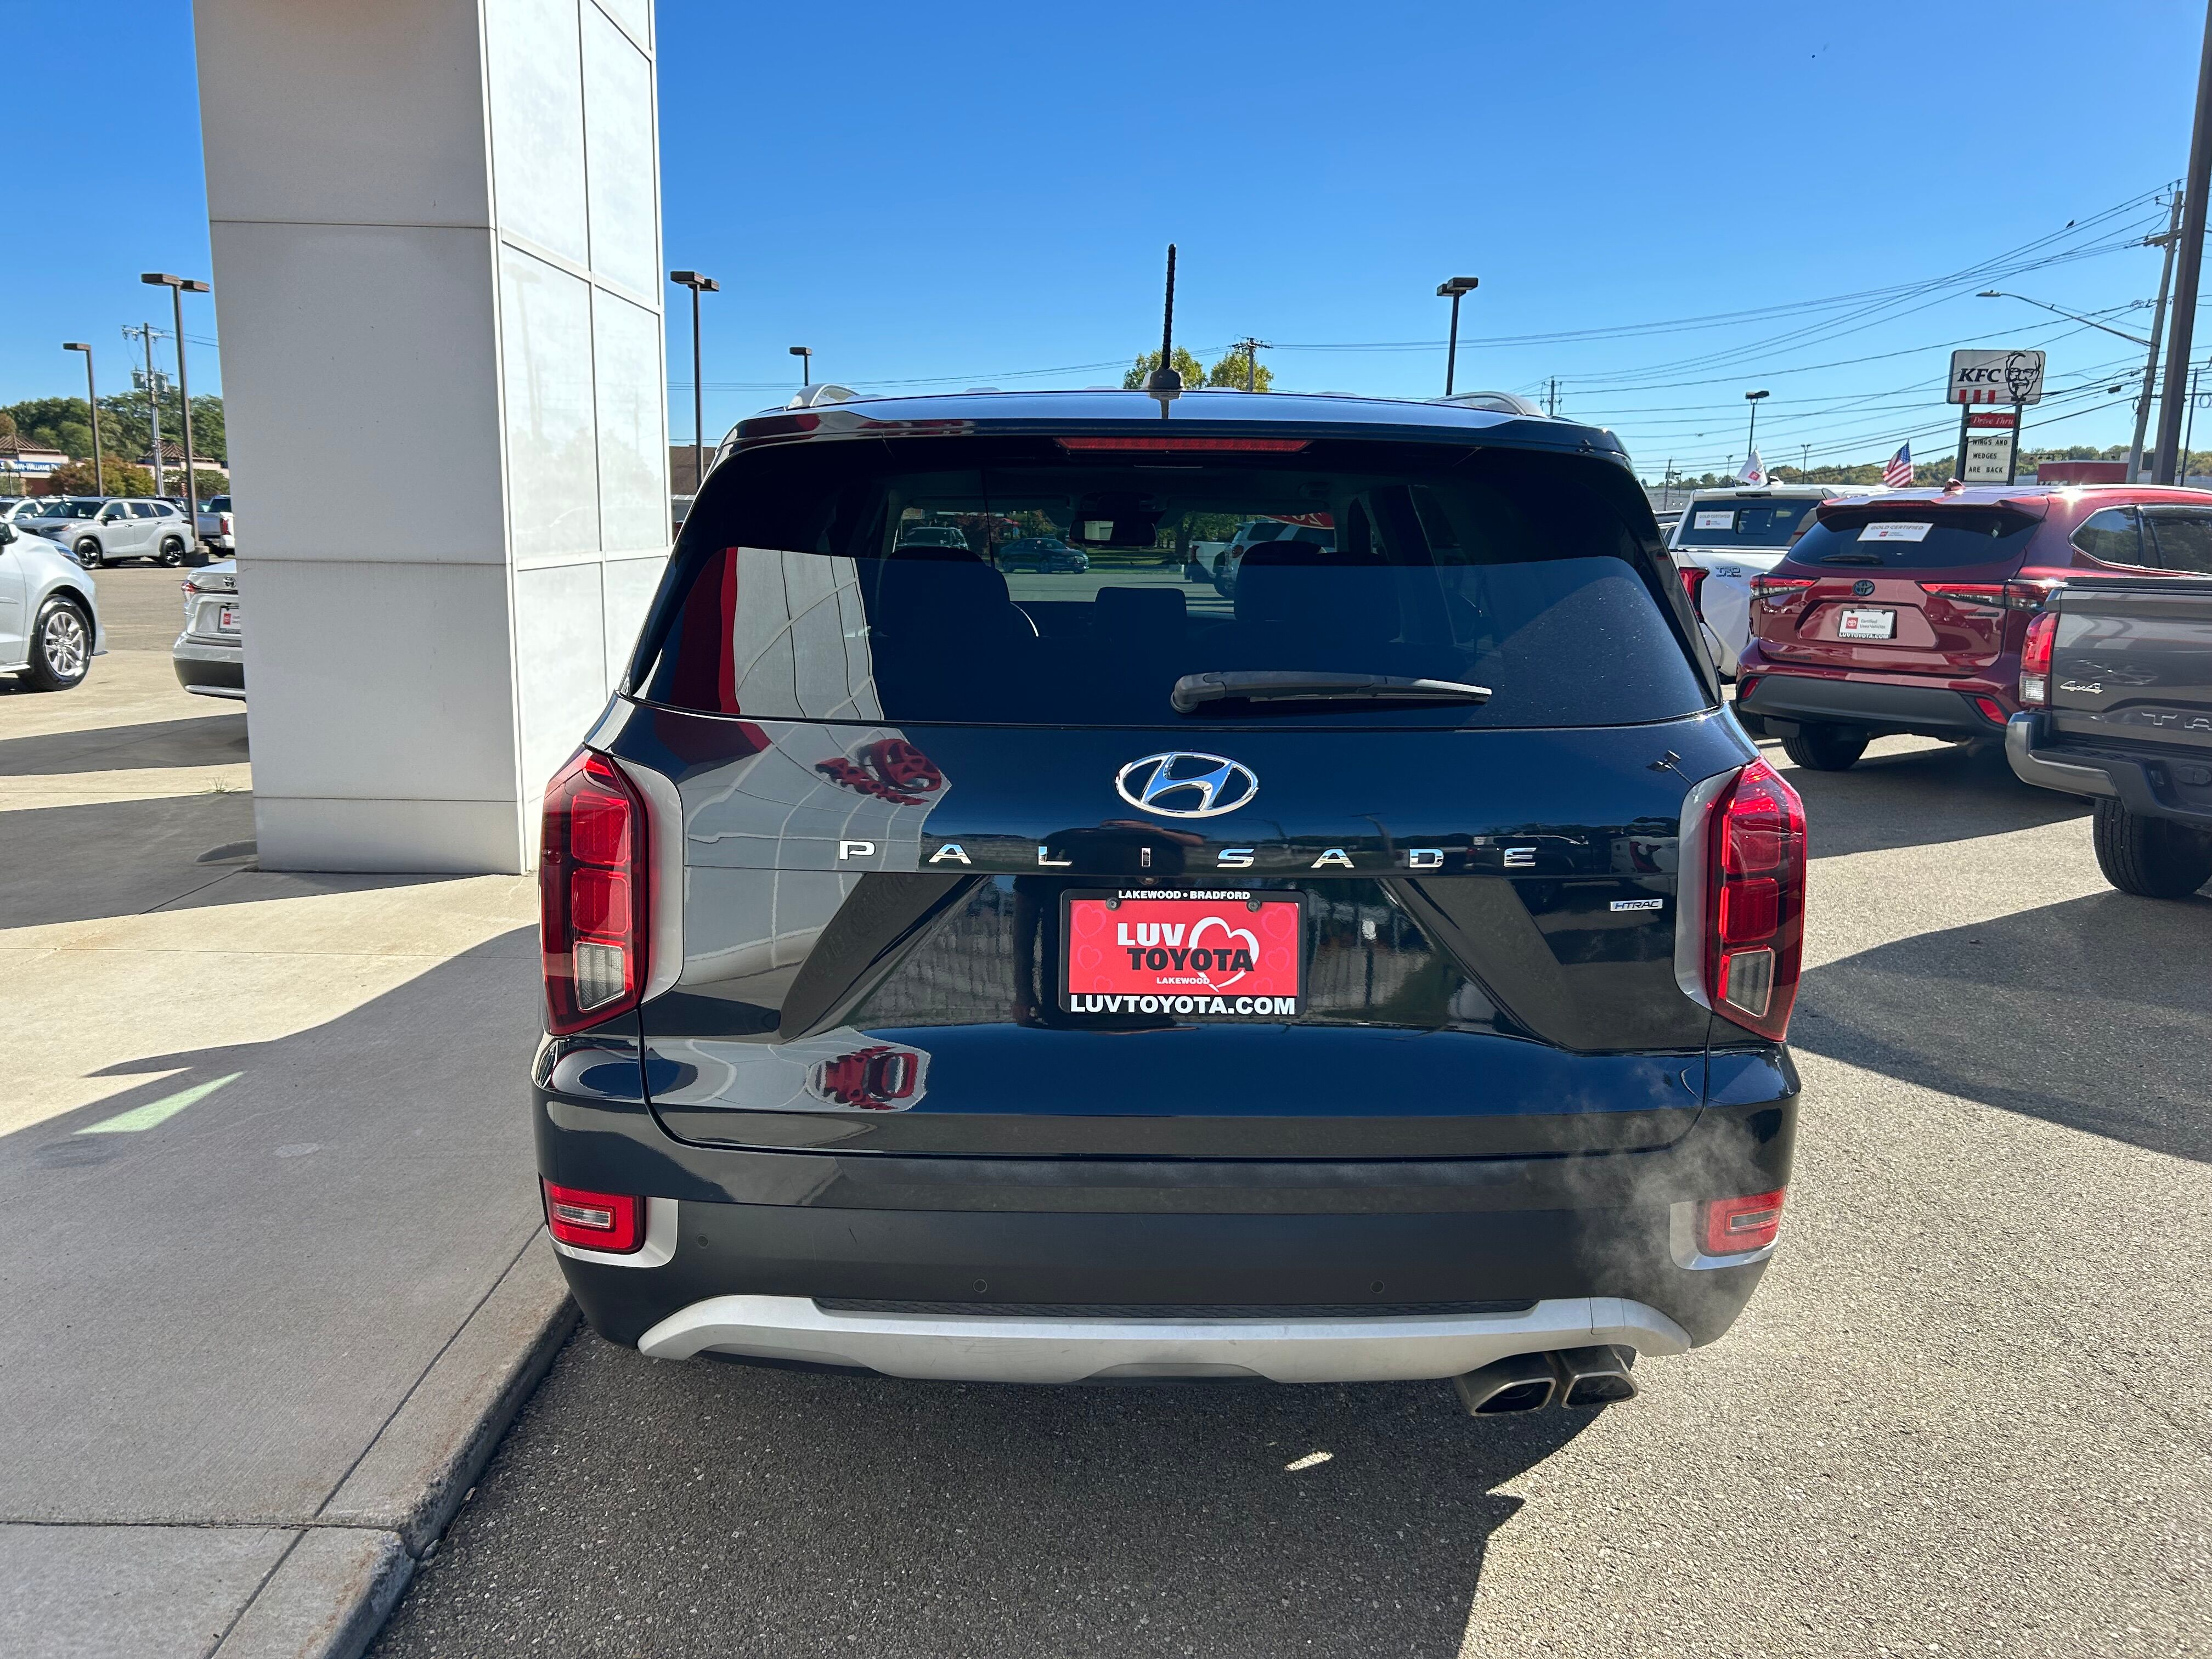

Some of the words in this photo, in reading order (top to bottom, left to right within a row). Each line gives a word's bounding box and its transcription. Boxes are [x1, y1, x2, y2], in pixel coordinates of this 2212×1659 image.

[1957, 368, 2001, 382] KFC
[1973, 416, 1994, 425] Drive
[1995, 416, 2015, 426] Thru
[2059, 680, 2104, 694] 4x4
[839, 840, 1537, 868] PALISADE
[1118, 890, 1182, 900] LAKEWOOD
[1189, 890, 1251, 900] BRADFORD
[1615, 900, 1660, 910] HTRAC
[1117, 922, 1186, 946] LUV
[1126, 947, 1255, 972] TOYOTA
[1155, 977, 1211, 985] LAKEWOOD
[1070, 994, 1296, 1015] LUVTOYOTA.COM
